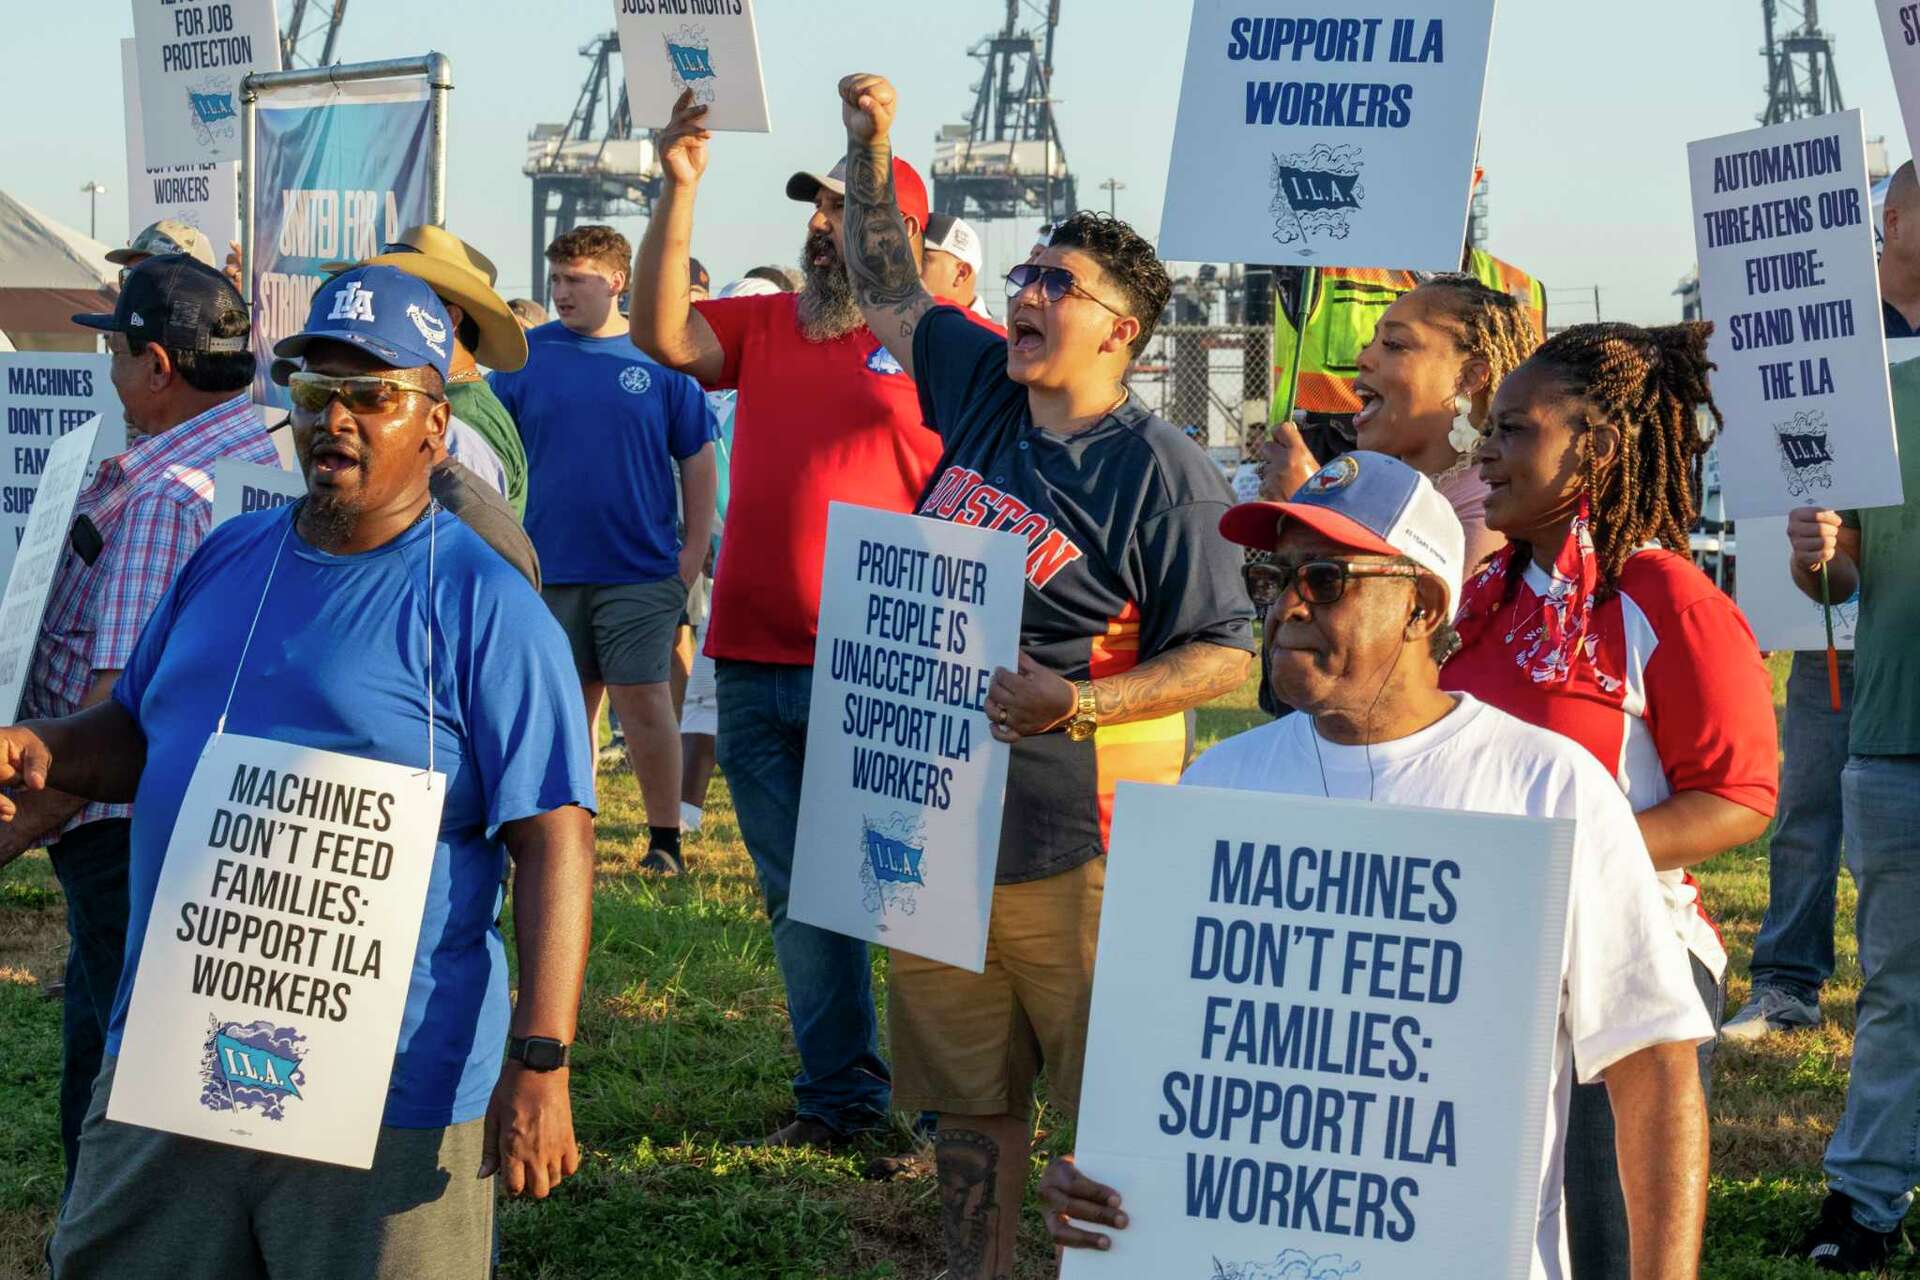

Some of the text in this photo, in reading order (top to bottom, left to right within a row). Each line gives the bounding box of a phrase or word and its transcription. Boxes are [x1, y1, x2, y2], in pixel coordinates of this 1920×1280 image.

[175, 4, 233, 37] FOR JOB
[1227, 17, 1444, 63] SUPPORT ILA
[162, 35, 252, 72] PROTECTION
[1245, 81, 1413, 128] WORKERS
[153, 176, 209, 204] WORKERS
[1291, 177, 1350, 202] I.L.A.
[1713, 135, 1841, 194] AUTOMATION
[280, 189, 339, 258] UNITED
[344, 190, 377, 261] FOR
[1703, 187, 1861, 248] THREATENS OUR
[1745, 249, 1826, 296] FUTURE:
[259, 272, 322, 338] STRON
[1729, 298, 1855, 351] STAND WITH
[8, 367, 93, 397] MACHINES
[1758, 357, 1835, 401] THE ILA
[8, 407, 53, 436] DON'T
[857, 540, 987, 606] PROFIT OVER
[866, 594, 968, 655] PEOPLE IS
[831, 638, 990, 711] UNACCEPTABLE
[843, 693, 970, 762] SUPPORT ILA
[228, 764, 395, 832] MACHINES
[852, 746, 953, 810] WORKERS
[208, 808, 394, 881] DON’T FEED
[210, 858, 369, 927] FAMILIES:
[1208, 839, 1461, 925] MACHINES
[176, 902, 382, 980] SUPPORT ILA
[1190, 916, 1463, 1005] DON’T FEED
[192, 954, 351, 1022] WORKERS
[224, 1048, 284, 1085] I.L.A.
[1200, 996, 1433, 1083] FAMILIES:
[1159, 1071, 1457, 1167] SUPPORT ILA
[1186, 1152, 1419, 1243] WORKERS
